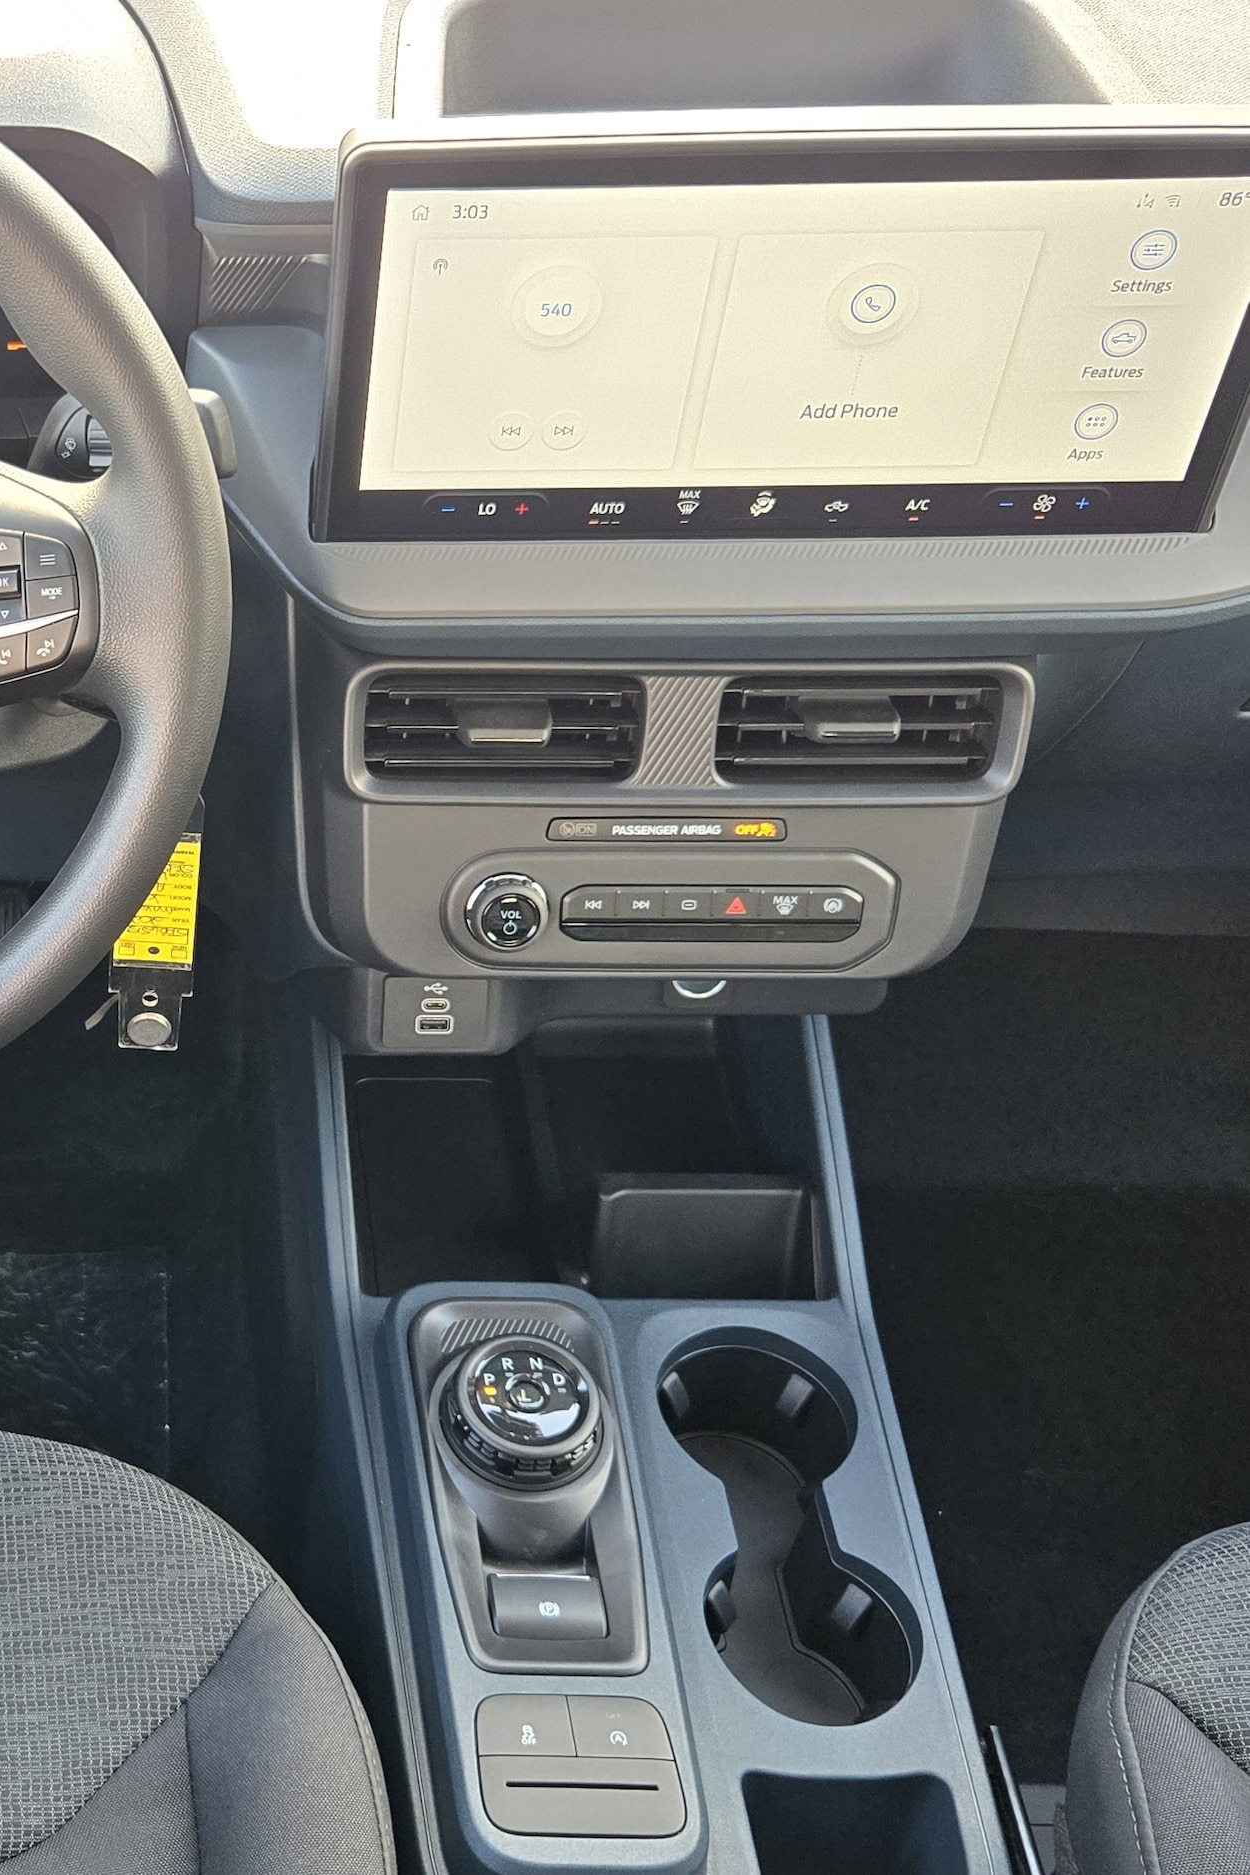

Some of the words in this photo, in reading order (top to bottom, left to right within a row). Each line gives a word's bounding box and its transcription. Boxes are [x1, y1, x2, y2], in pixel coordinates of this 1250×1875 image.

[452, 204, 489, 220] 3:03
[1110, 278, 1173, 295] Settings
[540, 303, 573, 318] 540
[1081, 365, 1144, 379] Features
[800, 403, 838, 420] Add
[840, 403, 899, 419] Phone
[1066, 447, 1104, 463] Apps
[678, 490, 701, 500] MAX
[477, 502, 497, 517] LO
[589, 501, 625, 516] AUTO
[905, 498, 931, 512] A/C
[41, 586, 63, 597] MODE
[611, 824, 678, 836] PASSENGER
[680, 824, 723, 836] AIRBAG
[734, 823, 758, 837] OFF
[772, 895, 799, 905] MAX
[500, 909, 522, 920] VOL
[483, 1373, 496, 1385] P
[501, 1357, 515, 1370] R
[529, 1357, 544, 1370] N
[552, 1373, 567, 1385] D
[521, 1389, 532, 1402] L
[521, 1737, 537, 1745] OFF
